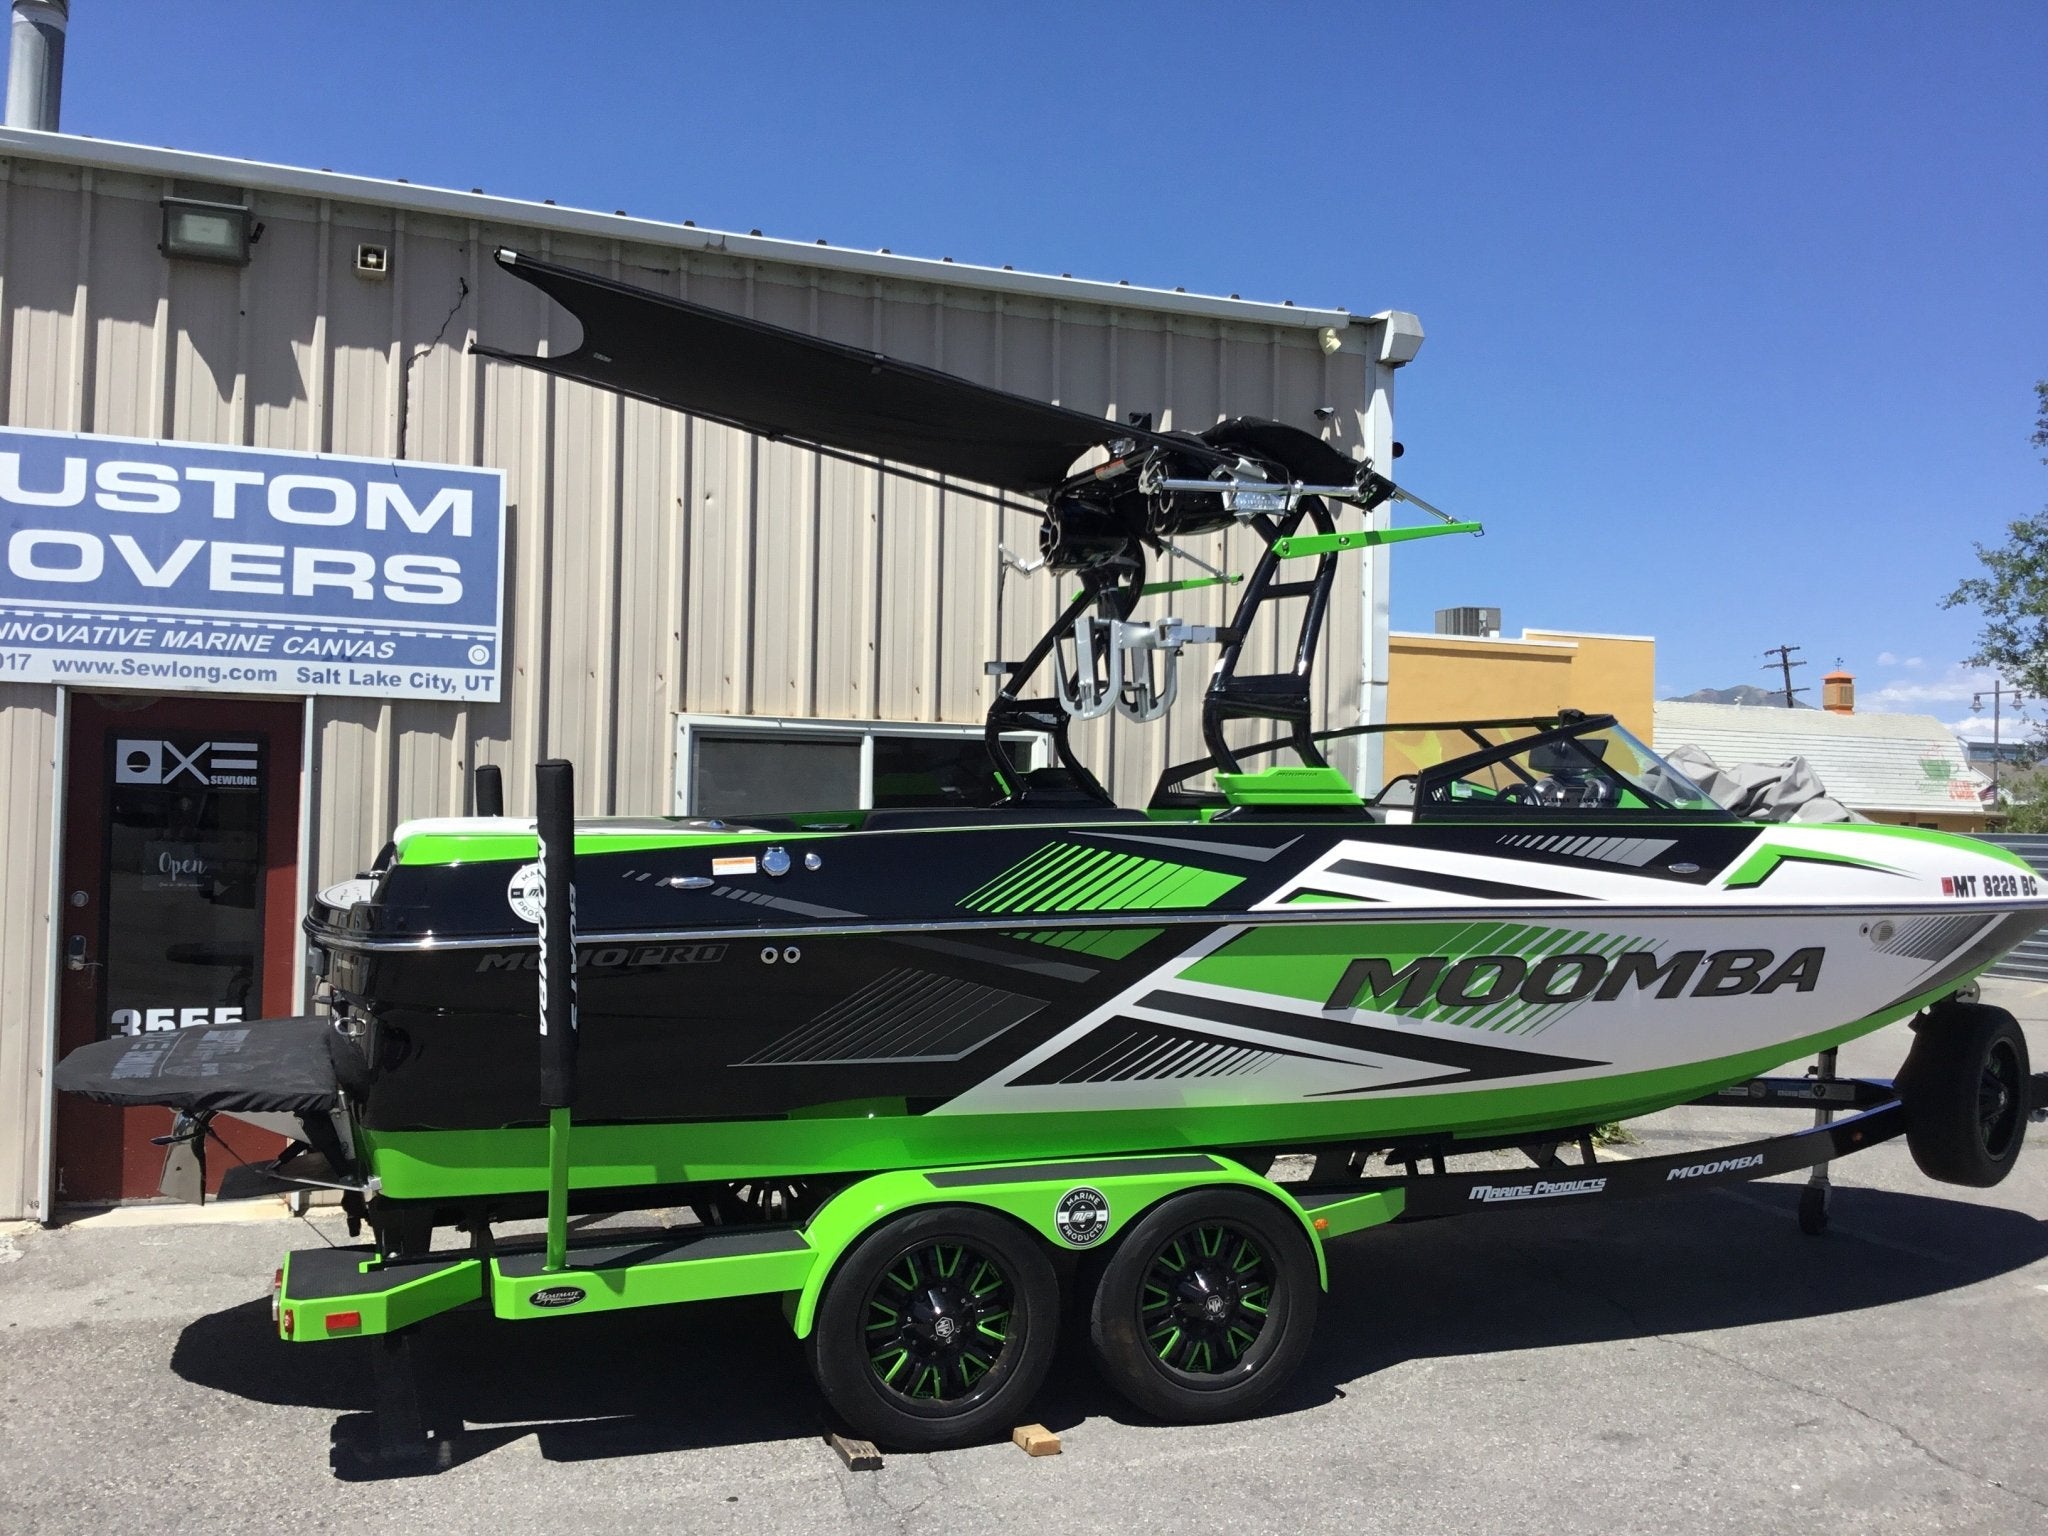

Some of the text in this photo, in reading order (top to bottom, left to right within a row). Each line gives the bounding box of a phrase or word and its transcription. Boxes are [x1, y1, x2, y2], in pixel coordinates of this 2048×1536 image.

[8, 529, 464, 605] OVERS
[160, 630, 273, 654] MARINE
[282, 637, 397, 659] CANVAS
[52, 657, 278, 684] www.Sewlong.com
[296, 666, 341, 686] Salt
[349, 669, 402, 688] Lake
[410, 672, 457, 693] City,
[465, 675, 494, 692] UT
[210, 775, 257, 786] SEWLONG
[158, 851, 208, 881] Open
[1953, 875, 2038, 898] MT 8228 BC
[1322, 946, 1826, 1012] MOOMBA
[1666, 1153, 1764, 1181] MOOMBA
[1066, 1192, 1101, 1206] MARINE
[1062, 1223, 1103, 1241] PRODUCTS
